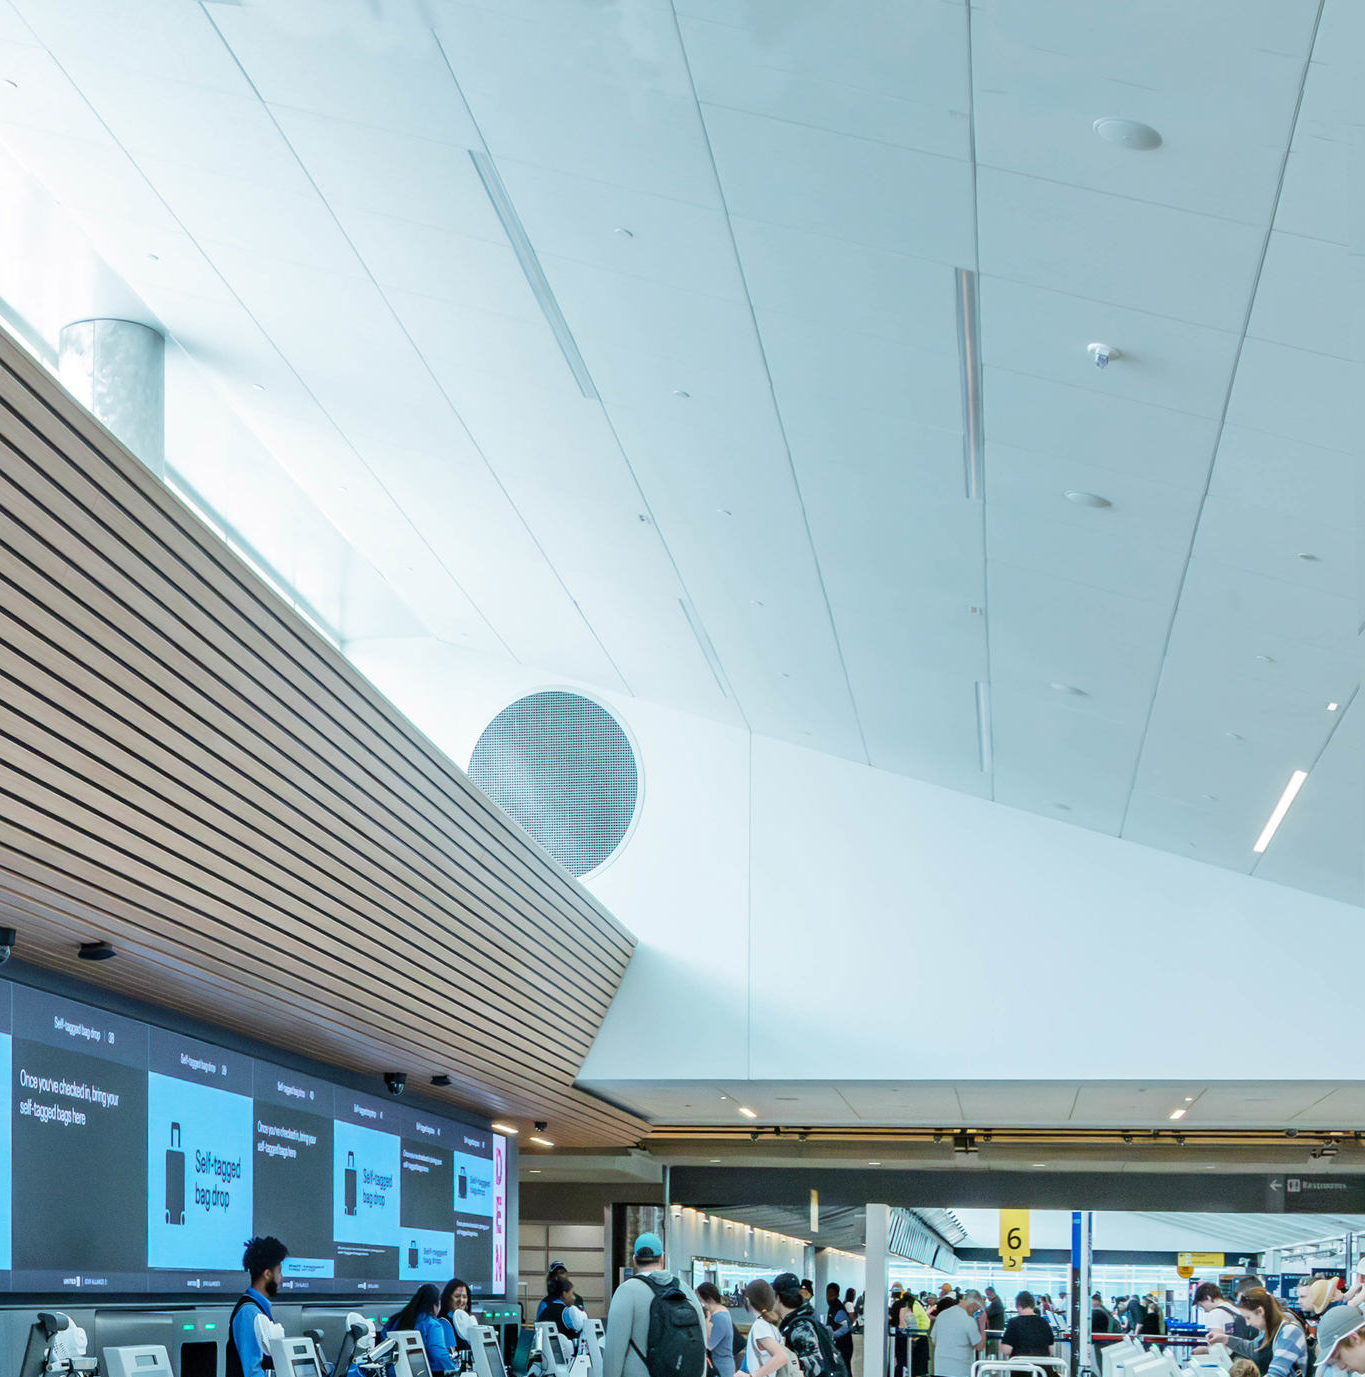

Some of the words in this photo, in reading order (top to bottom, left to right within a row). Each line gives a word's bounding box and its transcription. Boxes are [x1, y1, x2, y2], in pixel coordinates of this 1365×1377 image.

[20, 1068, 37, 1089] Once
[20, 1099, 56, 1123] self-tagged
[72, 1107, 86, 1126] here
[195, 1149, 241, 1184] Self-tagged
[195, 1182, 210, 1212] bag
[212, 1184, 230, 1213] drop
[1007, 1227, 1022, 1250] 6
